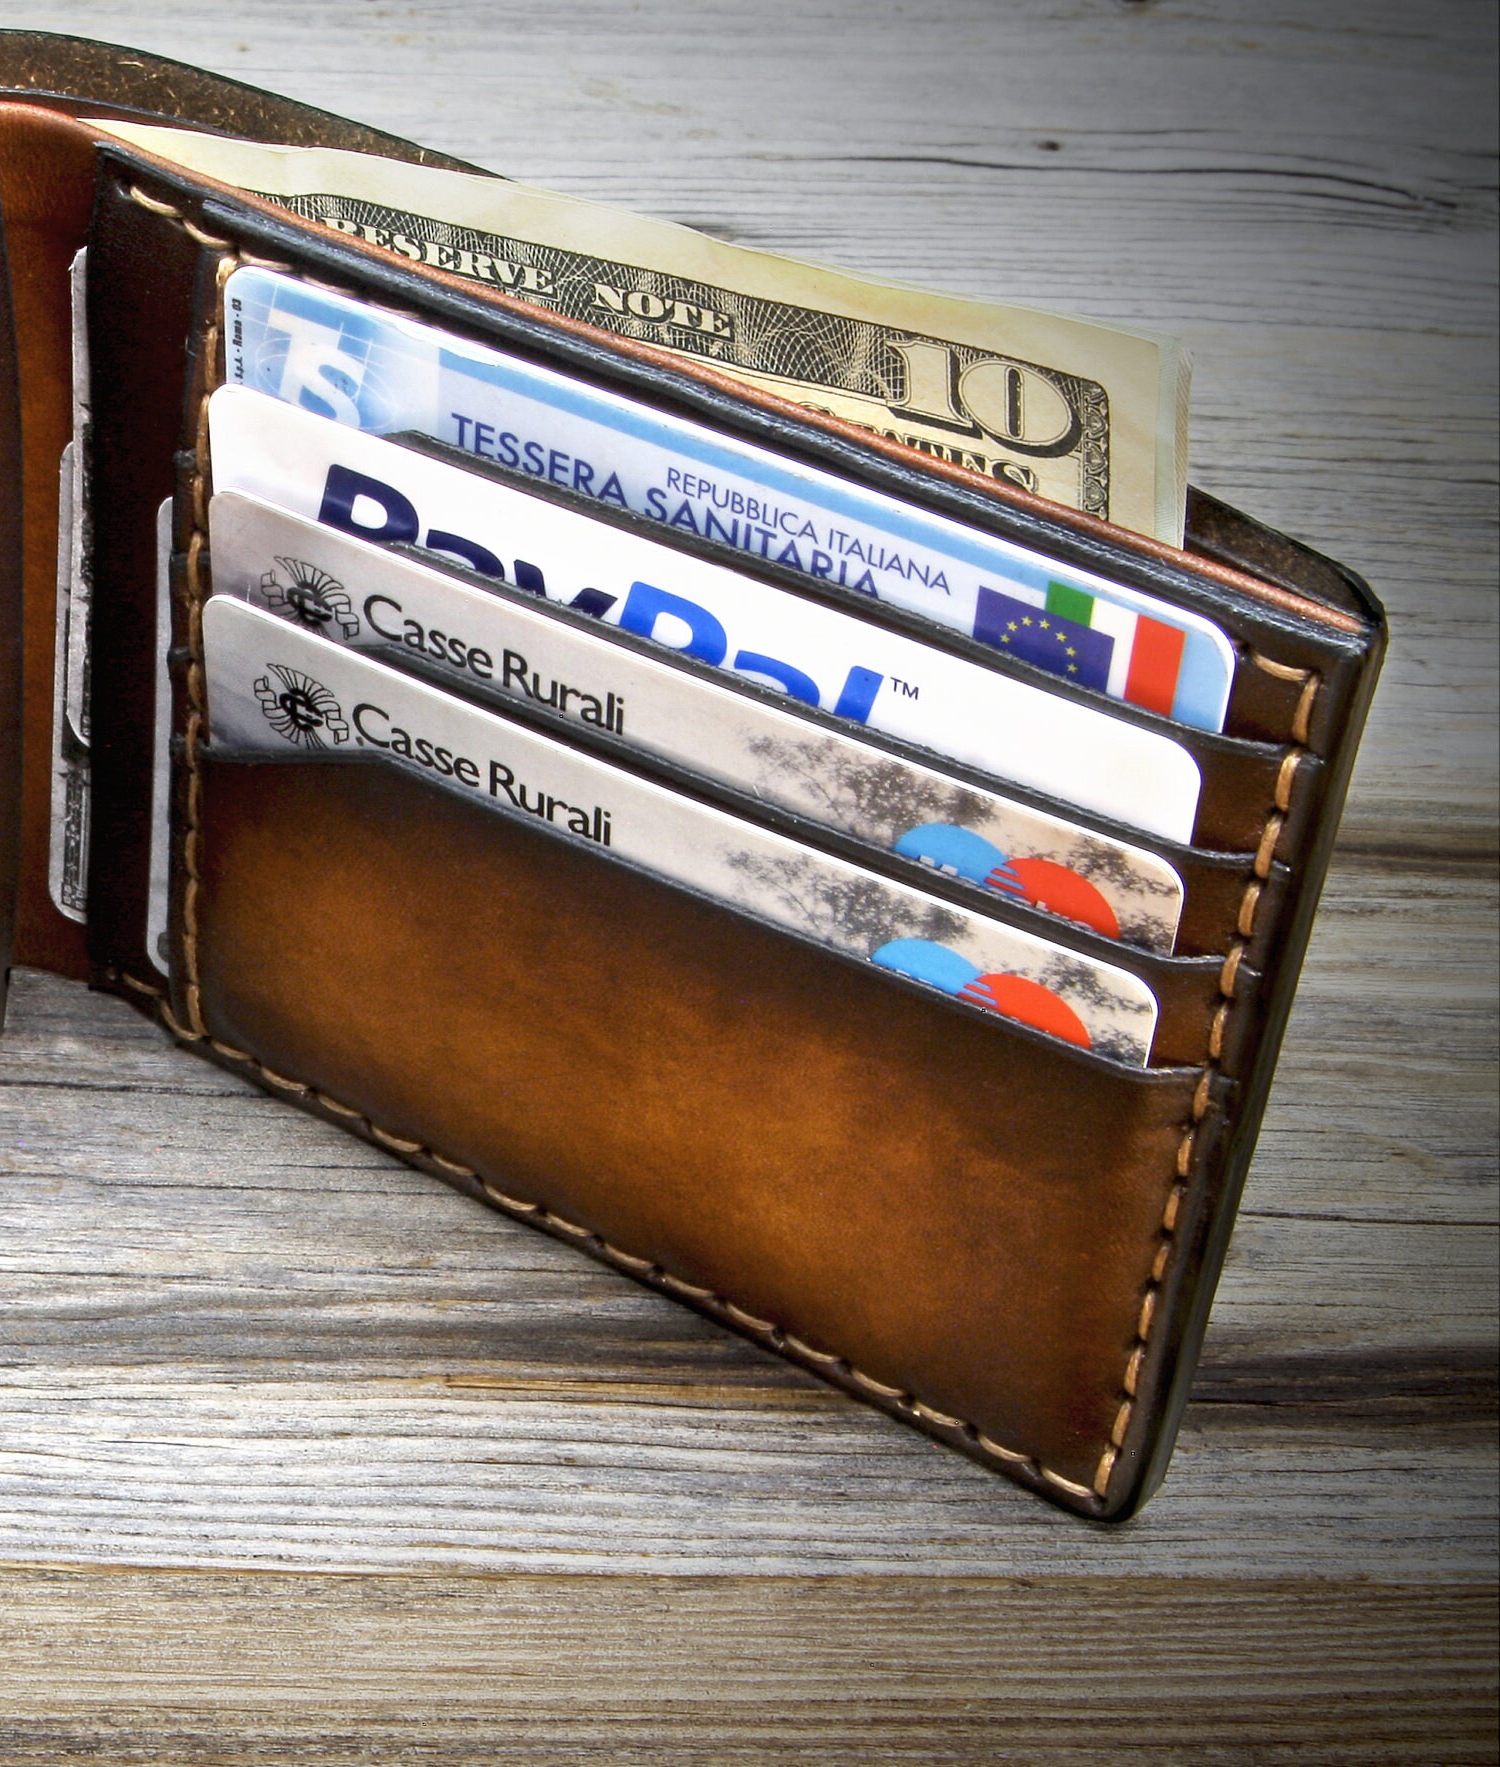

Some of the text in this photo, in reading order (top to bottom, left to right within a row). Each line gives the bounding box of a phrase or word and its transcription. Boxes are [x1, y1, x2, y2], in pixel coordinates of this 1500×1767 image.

[232, 320, 243, 348] Roma
[321, 217, 735, 341] RESERVE NOTE
[268, 308, 361, 429] TS
[885, 340, 1083, 458] 10
[451, 412, 880, 600] TESSERA SANITARIA
[667, 466, 951, 596] REPUBBLICA ITALIANA
[363, 594, 624, 735] Casse Rurali
[352, 703, 612, 846] Casse Rurali
